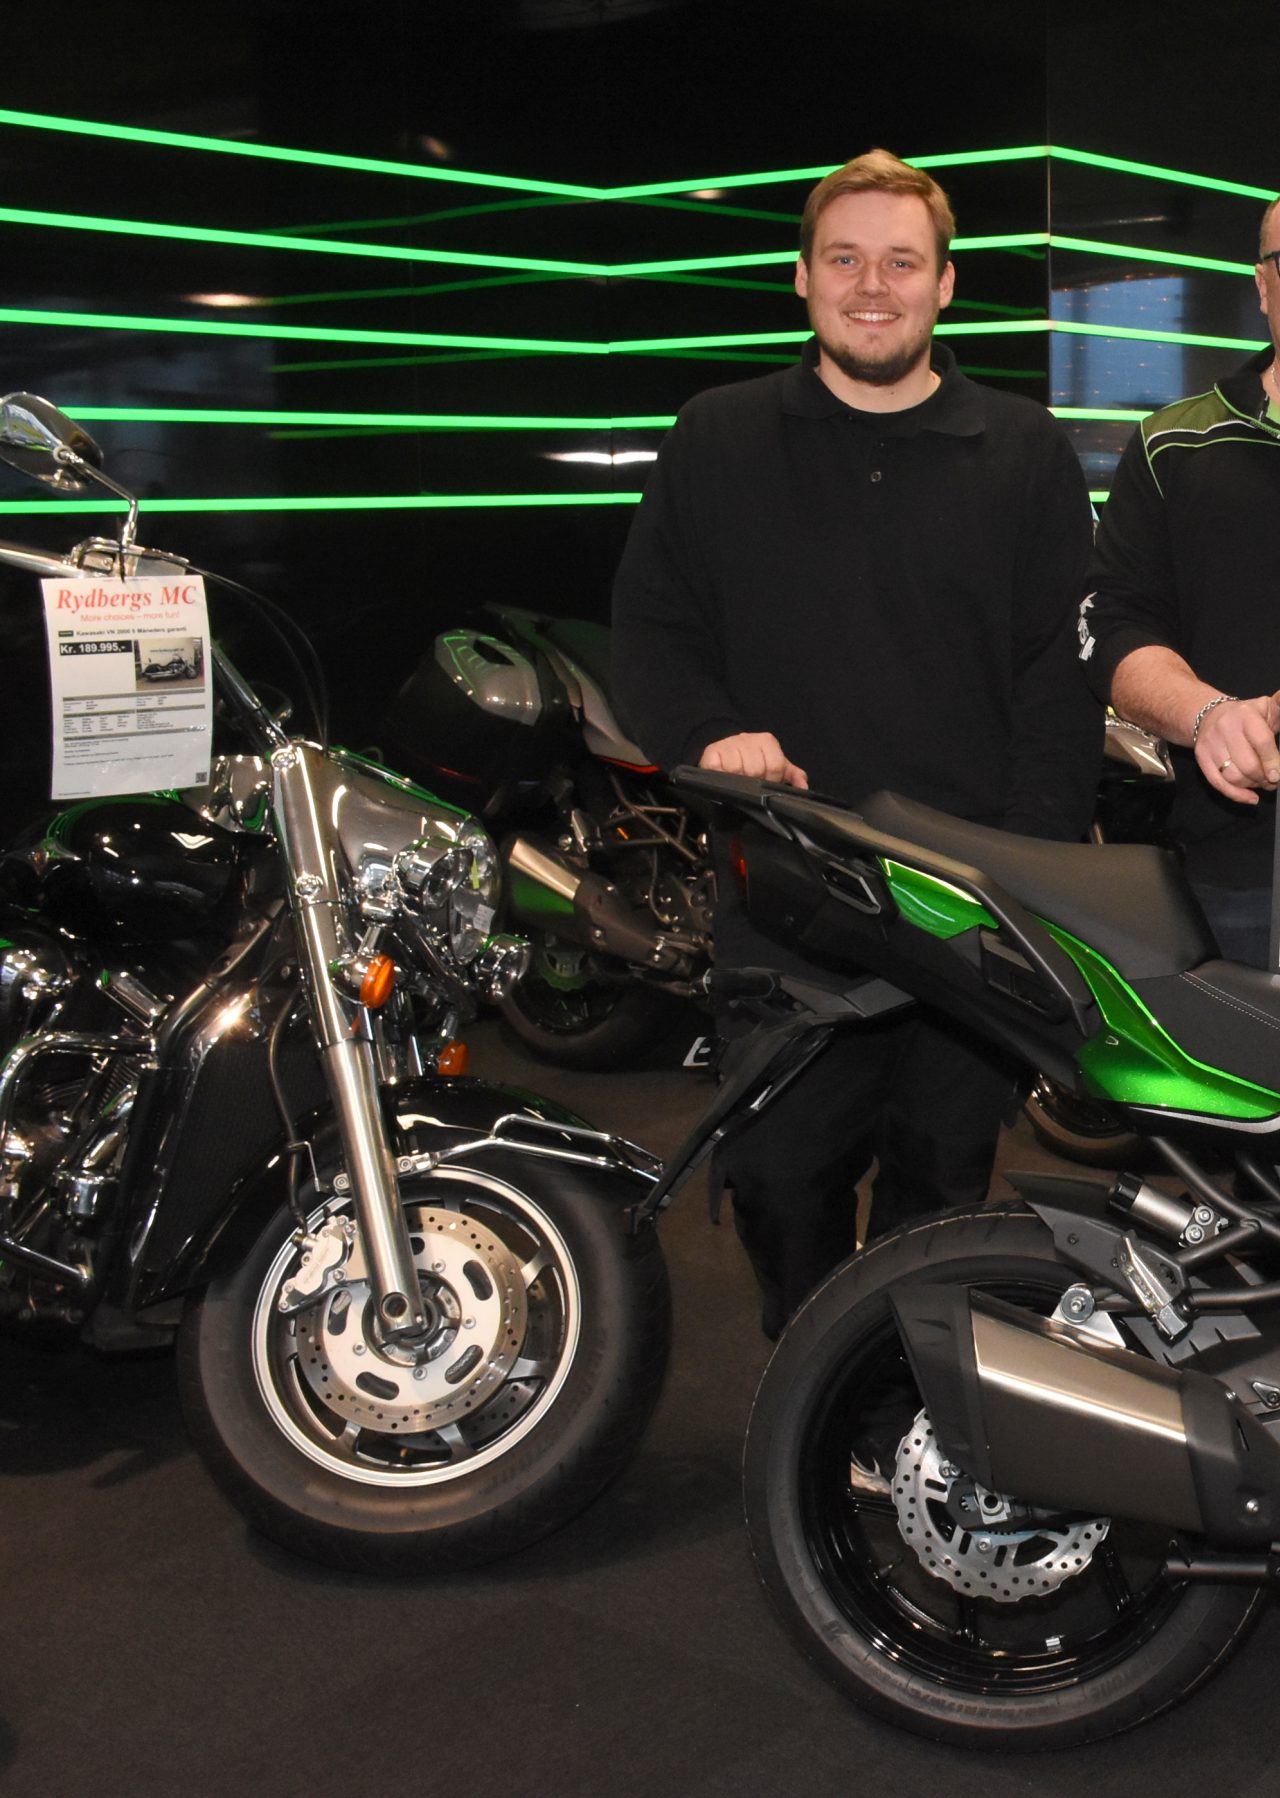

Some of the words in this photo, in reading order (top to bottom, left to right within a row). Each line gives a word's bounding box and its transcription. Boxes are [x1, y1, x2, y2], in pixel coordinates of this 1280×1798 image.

[56, 587, 152, 614] Rydbergs
[160, 585, 197, 606] MC
[80, 614, 103, 622] More
[104, 612, 135, 622] choices
[143, 612, 162, 620] more
[60, 644, 77, 654] Kr.
[79, 642, 126, 653] 189.995,-
